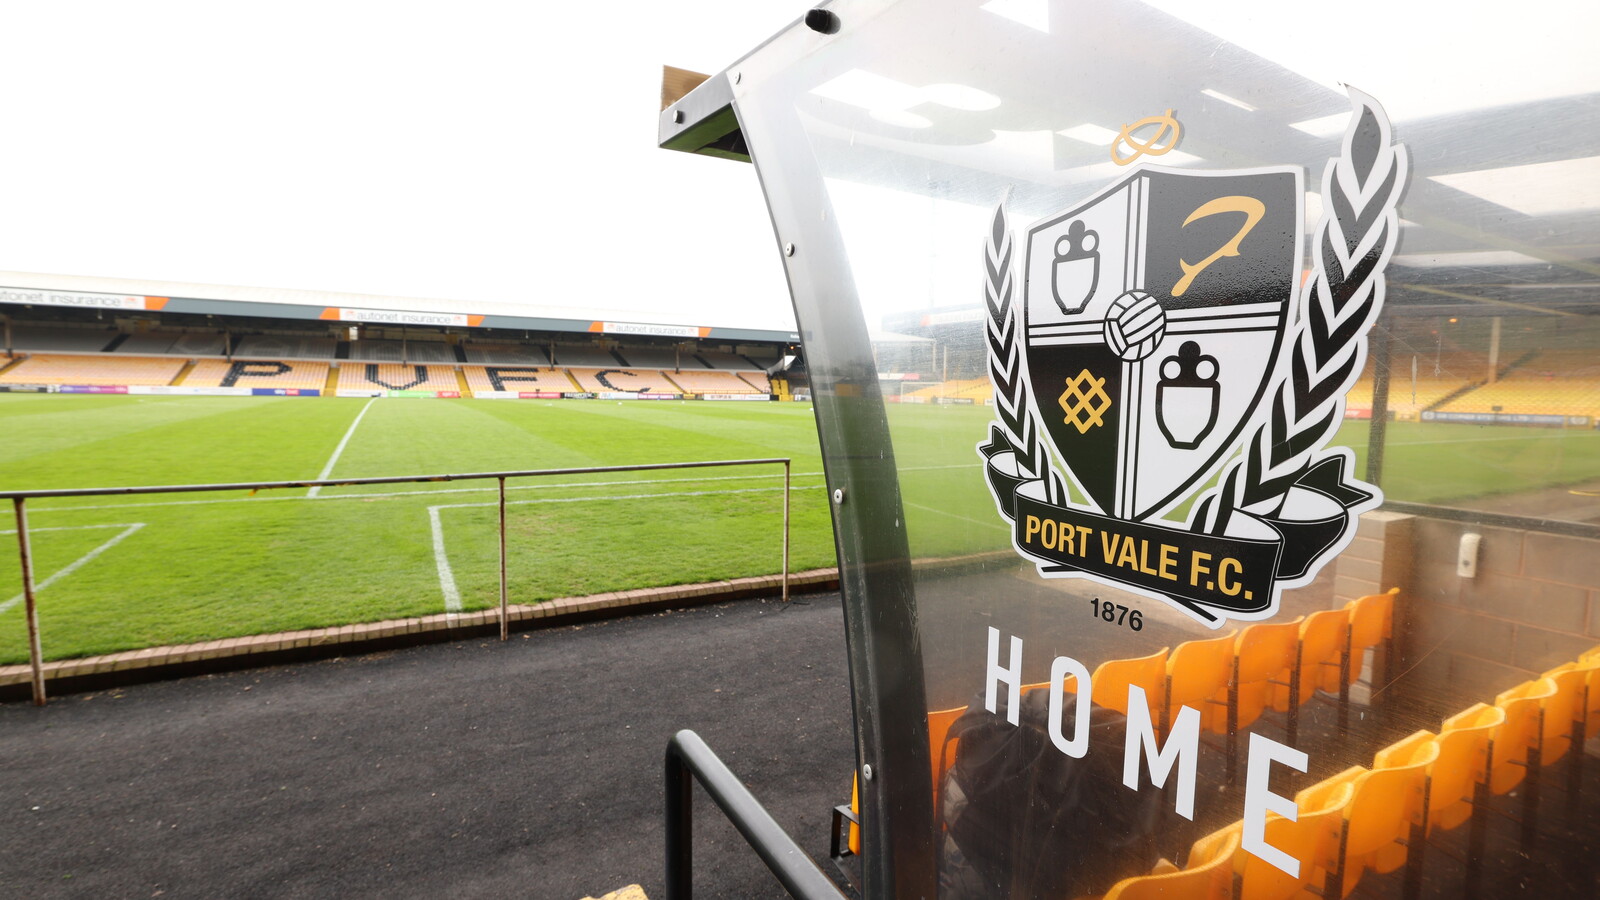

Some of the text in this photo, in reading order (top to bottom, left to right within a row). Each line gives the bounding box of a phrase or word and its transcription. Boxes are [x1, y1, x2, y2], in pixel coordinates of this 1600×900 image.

[49, 294, 121, 306] insurance
[357, 312, 451, 324] autonet insurance
[616, 324, 687, 335] autonet insurance
[1025, 514, 1253, 601] PORT VALE F.C.
[1090, 597, 1144, 632] 1876
[985, 626, 1309, 880] HOME
